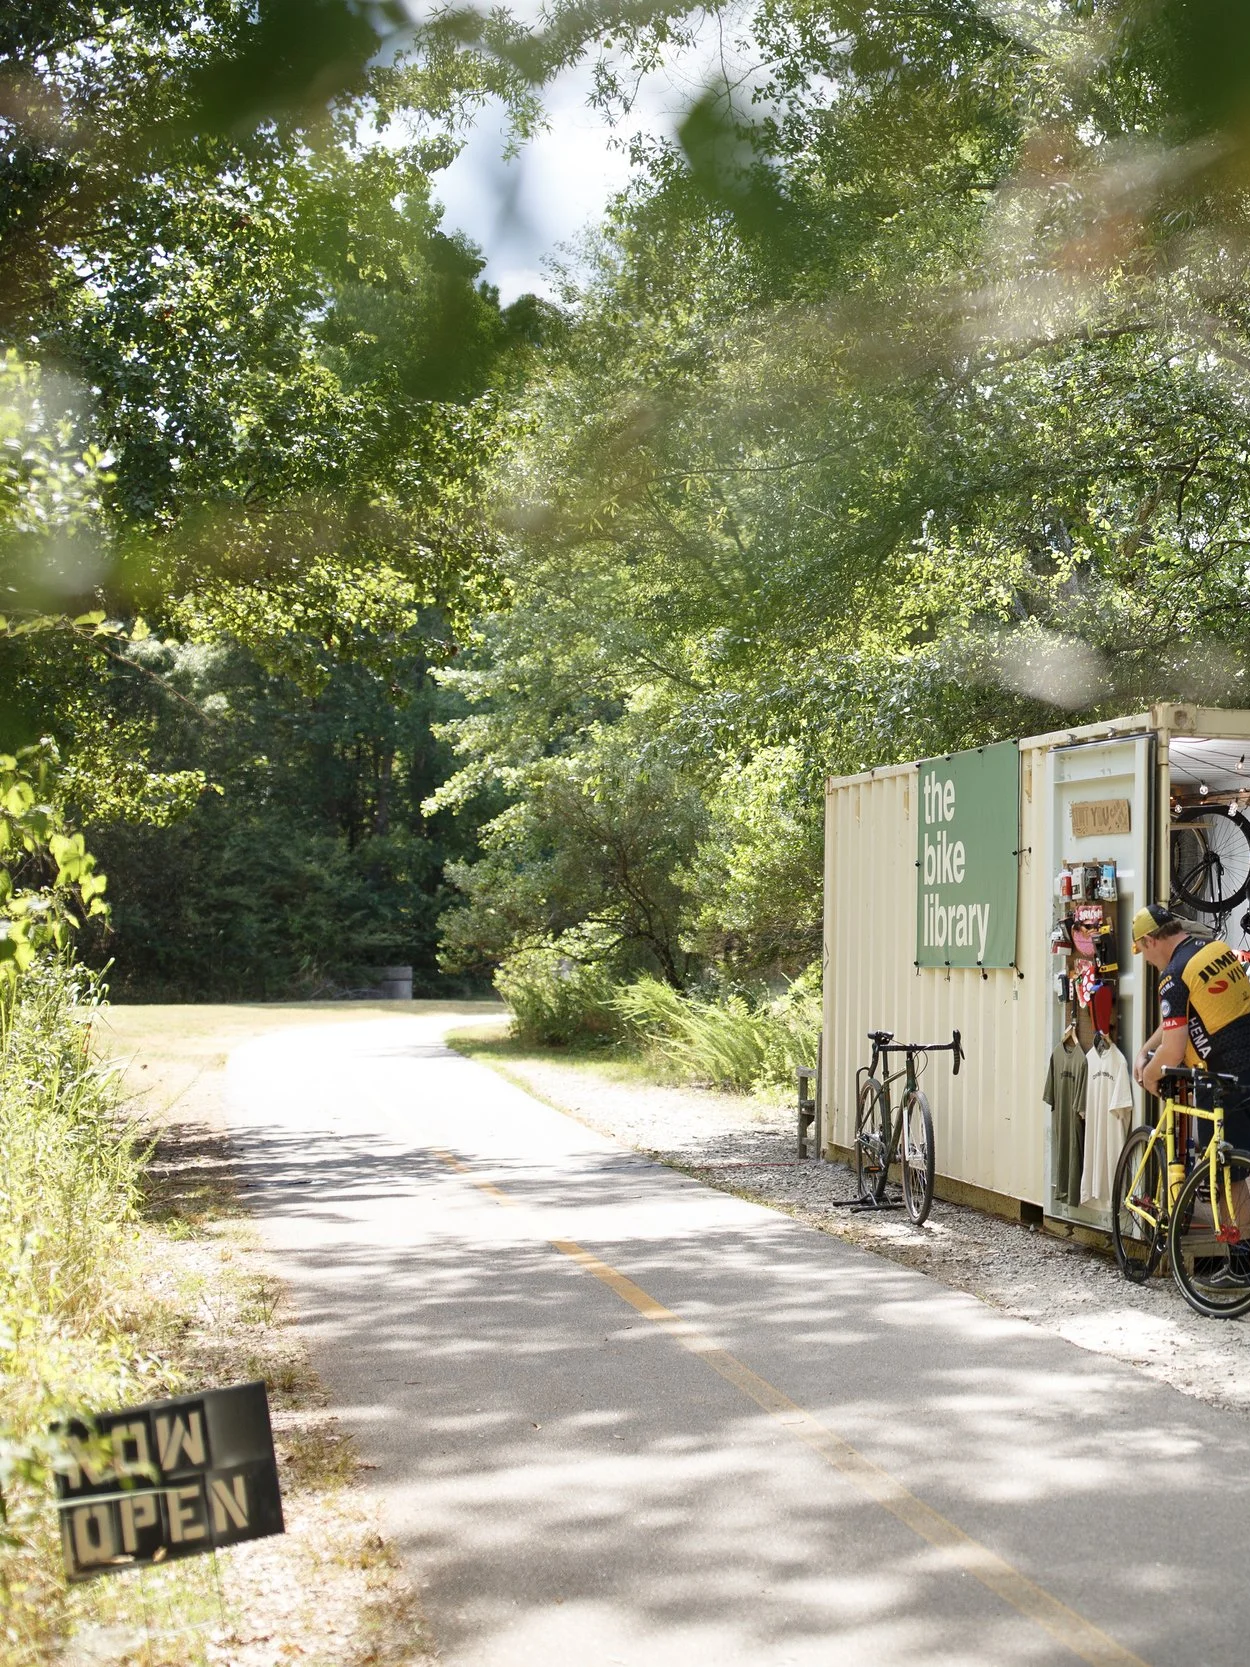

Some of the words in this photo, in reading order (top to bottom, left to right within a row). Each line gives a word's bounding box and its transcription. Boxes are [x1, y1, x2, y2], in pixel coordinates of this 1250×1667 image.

[923, 771, 956, 825] the
[1090, 806, 1109, 827] YOU
[923, 830, 966, 886] bike
[923, 893, 990, 961] library
[1188, 1016, 1212, 1060] HEMA
[72, 1475, 249, 1565] OPEN
